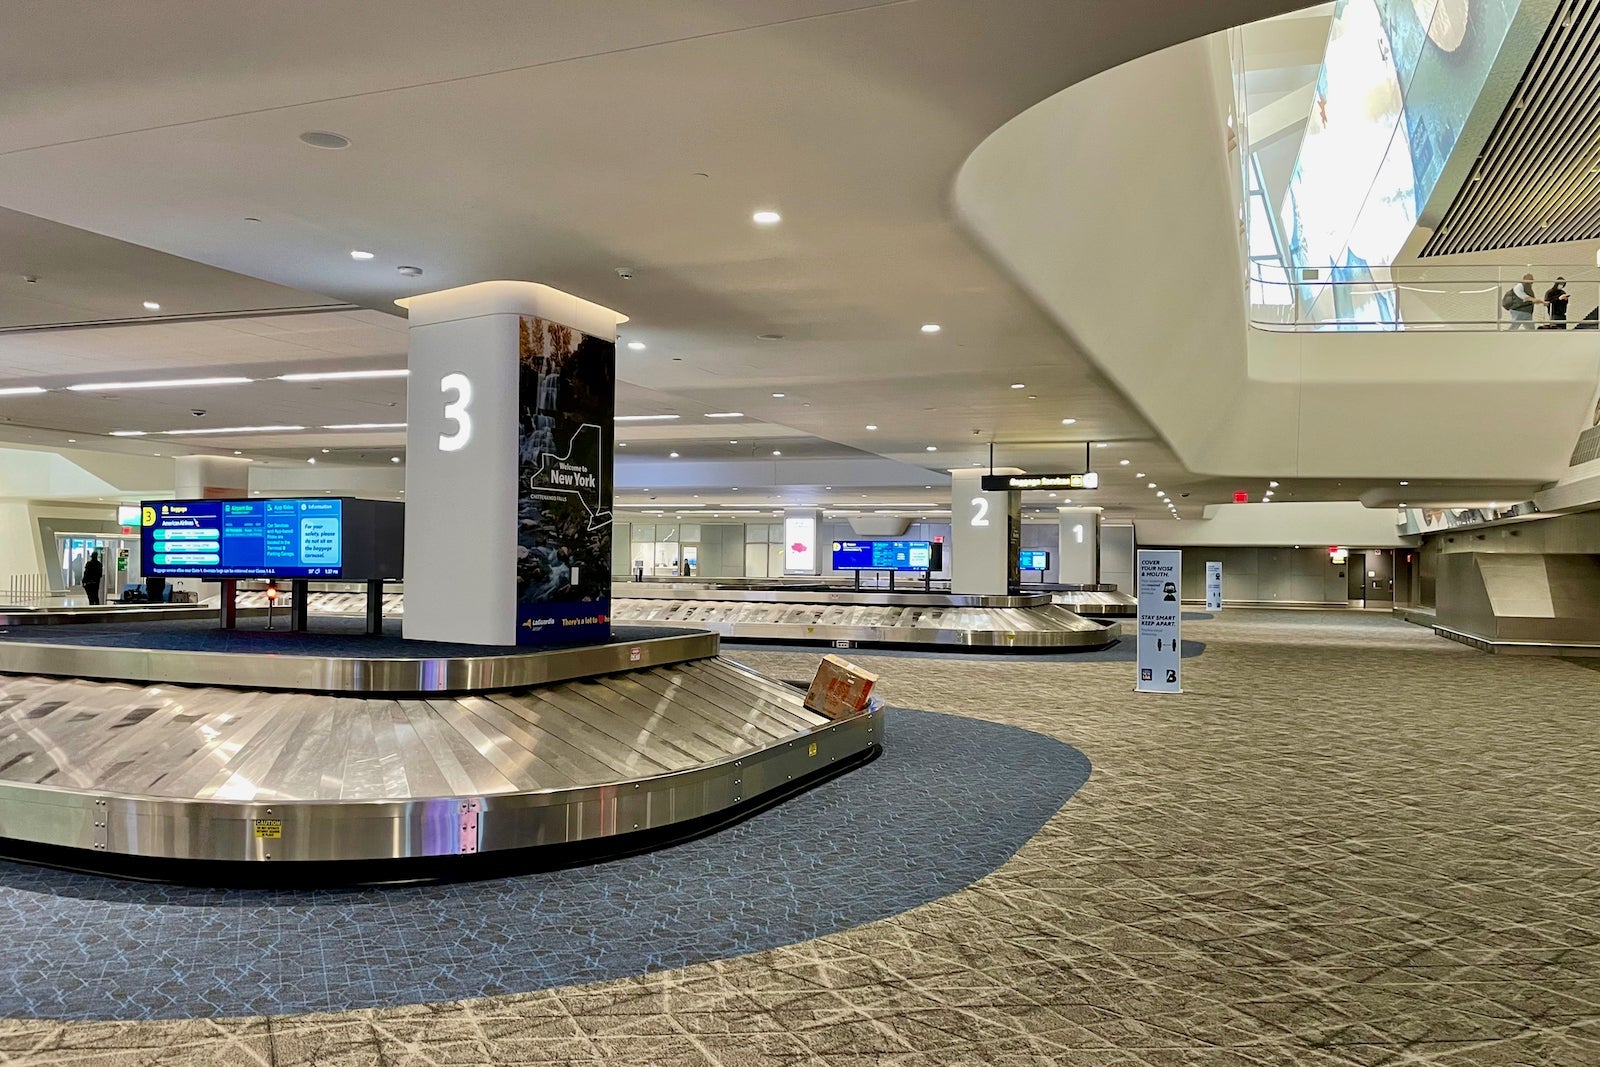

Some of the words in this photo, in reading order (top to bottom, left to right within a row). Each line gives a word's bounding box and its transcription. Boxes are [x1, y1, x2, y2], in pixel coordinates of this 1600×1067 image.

[439, 373, 472, 451] 3
[559, 462, 581, 472] Welcome
[551, 470, 573, 485] New
[573, 472, 595, 488] York
[146, 511, 151, 522] 3
[971, 497, 989, 526] 2
[1072, 524, 1083, 543] 1
[562, 618, 580, 626] There's
